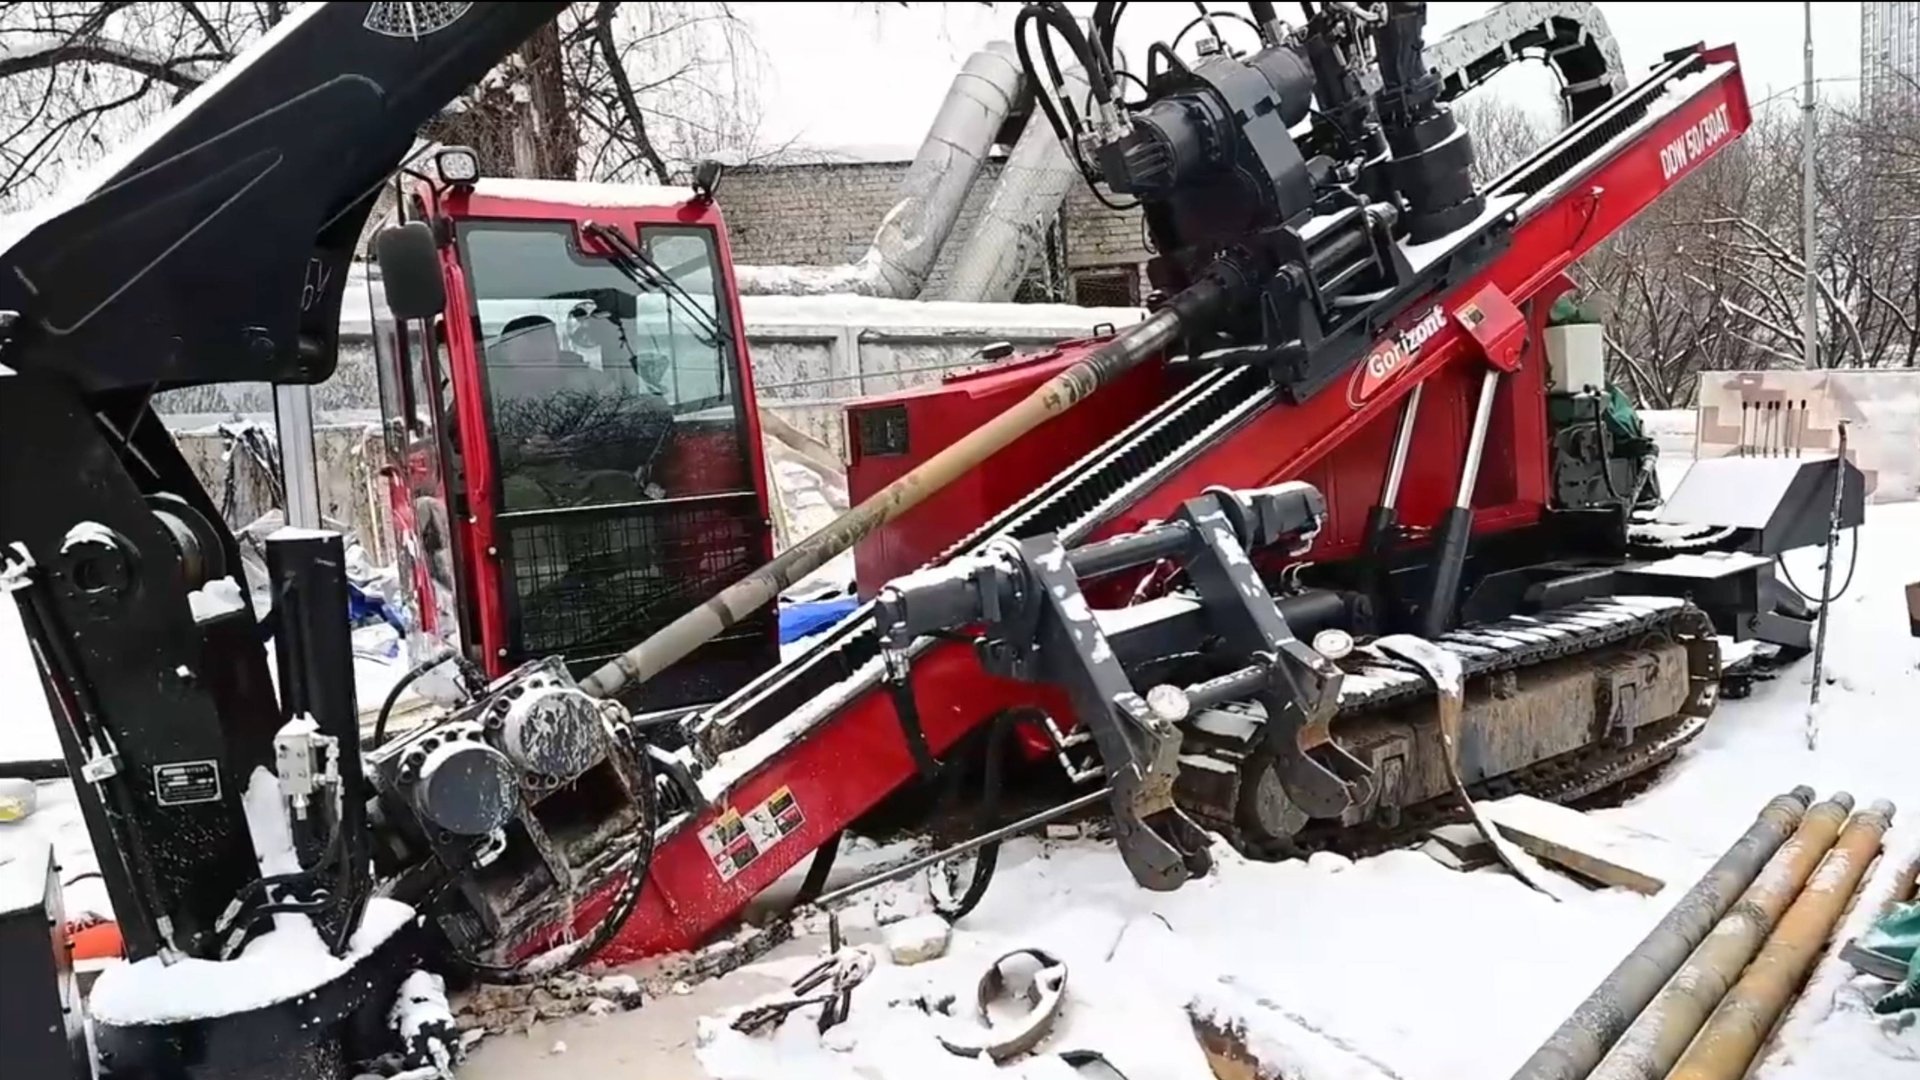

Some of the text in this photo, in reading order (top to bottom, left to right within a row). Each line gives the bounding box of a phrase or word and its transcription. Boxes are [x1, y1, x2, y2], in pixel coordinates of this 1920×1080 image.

[1660, 103, 1730, 180] DDW 50/30AT
[1368, 304, 1448, 379] Gorizont
